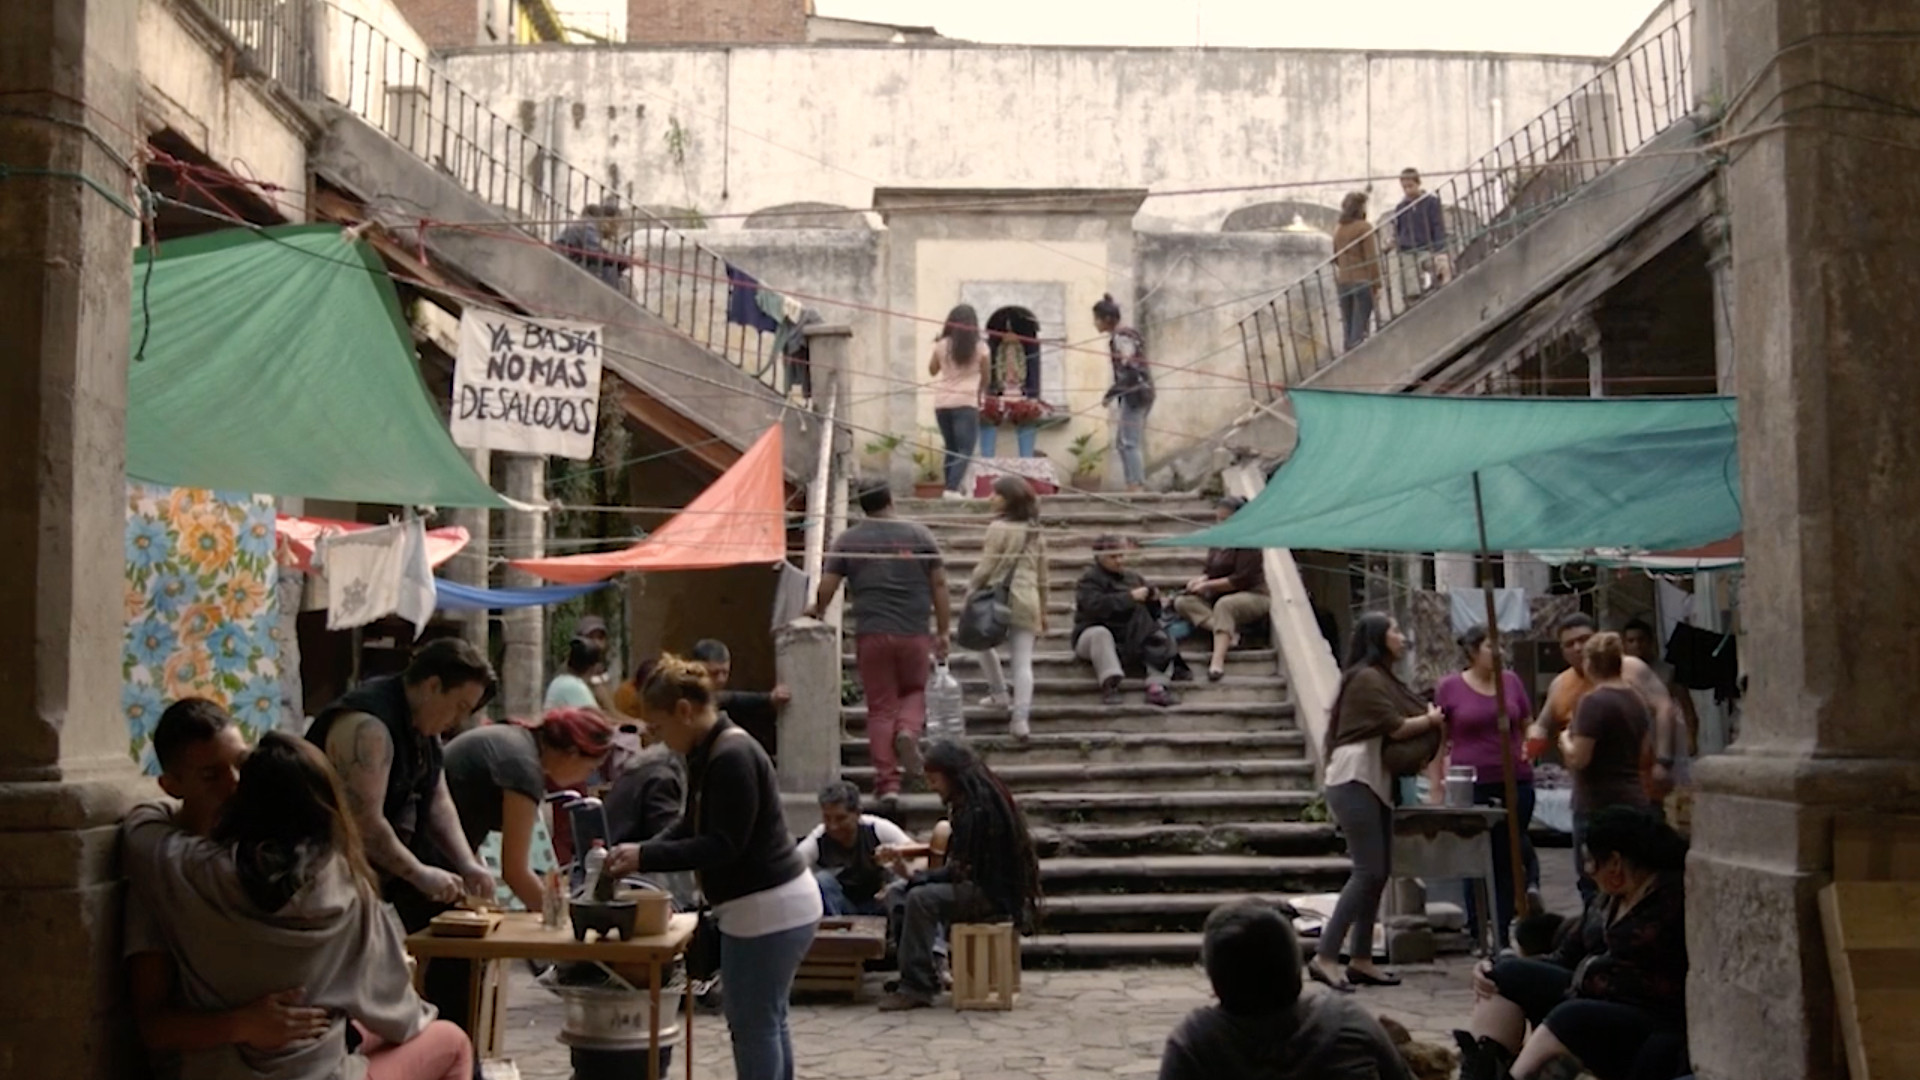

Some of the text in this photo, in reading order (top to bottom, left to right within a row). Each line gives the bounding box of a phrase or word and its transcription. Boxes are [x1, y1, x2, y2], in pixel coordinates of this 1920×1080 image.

[487, 322, 597, 357] YA BASTA
[487, 353, 587, 389] NO MAS
[460, 384, 594, 435] DESALOJOS
